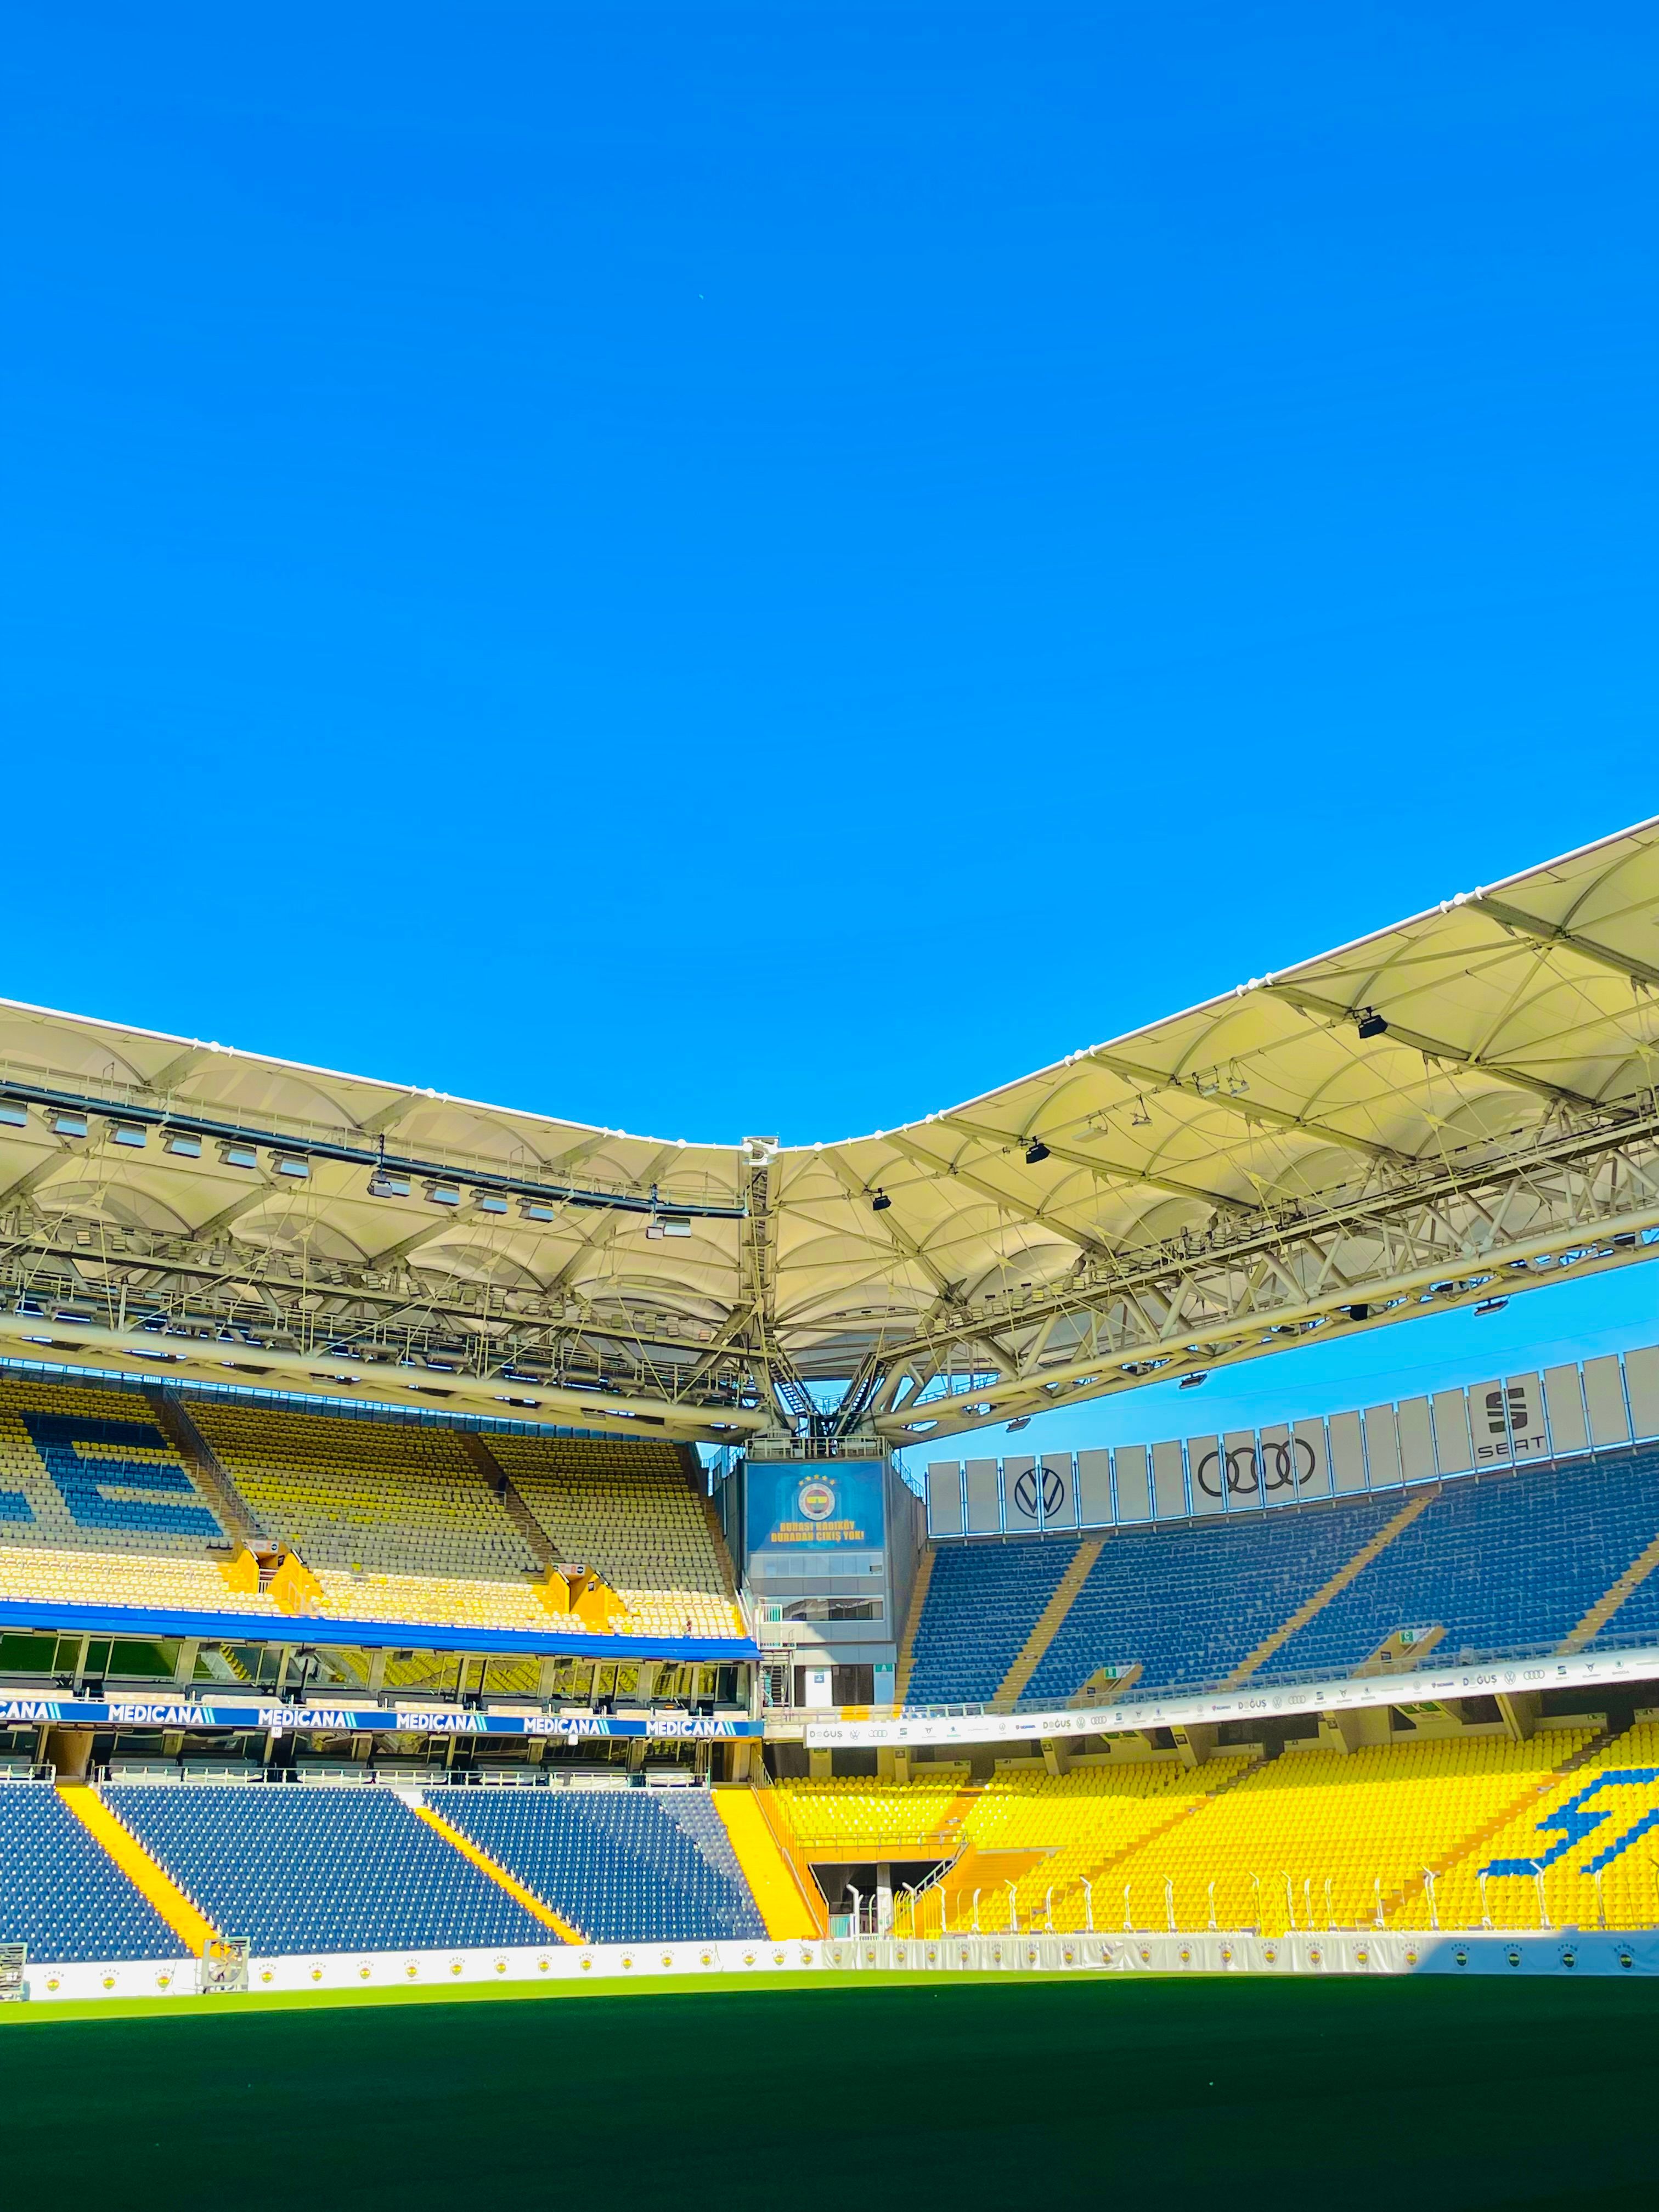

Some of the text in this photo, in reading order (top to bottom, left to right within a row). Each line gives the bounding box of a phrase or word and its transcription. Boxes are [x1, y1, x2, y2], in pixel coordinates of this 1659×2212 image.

[1478, 1435, 1545, 1459] SEAT
[843, 1531, 865, 1541] YOK!
[108, 1705, 204, 1724] MEDICANA
[258, 1709, 347, 1728] MEDICANA
[396, 1713, 478, 1731] MEDICANA
[523, 1718, 601, 1735] MEDICANA
[646, 1722, 726, 1735] MEDICANA
